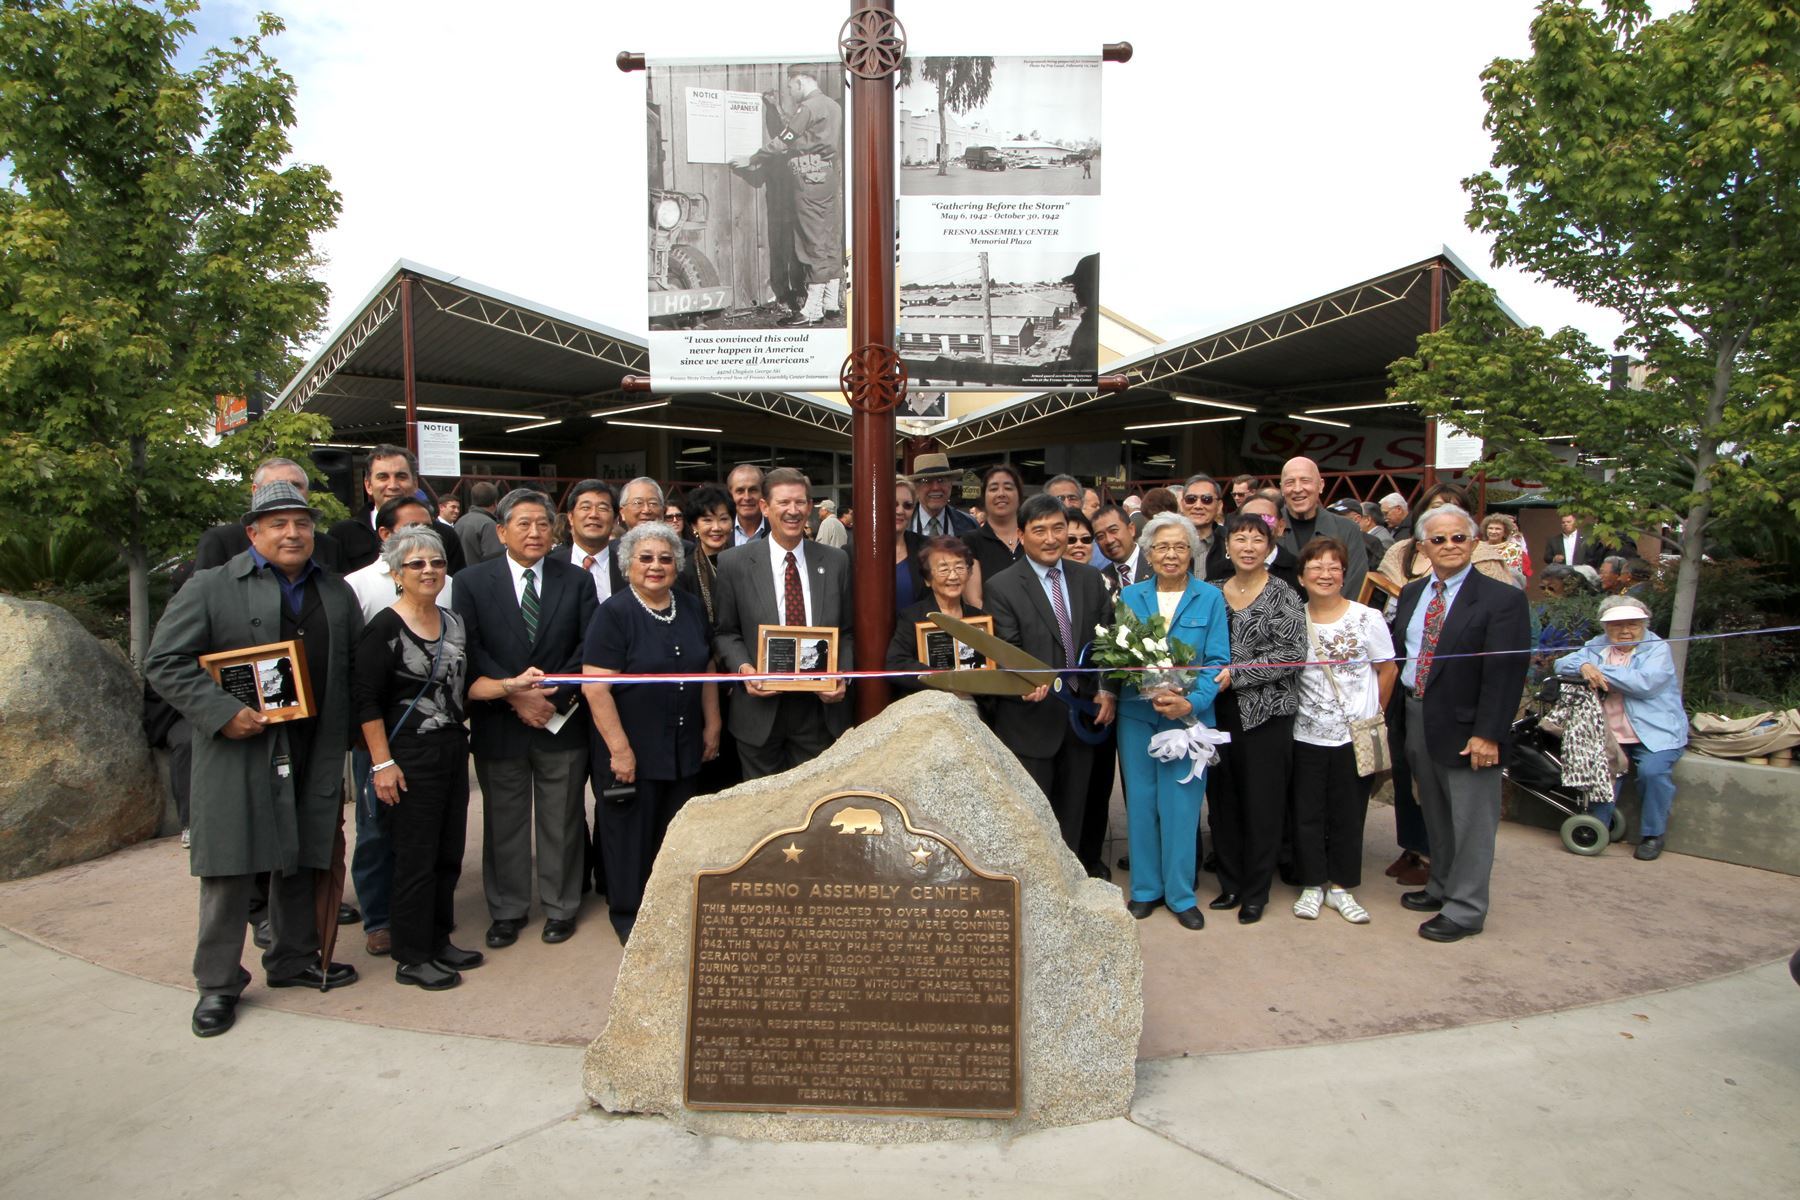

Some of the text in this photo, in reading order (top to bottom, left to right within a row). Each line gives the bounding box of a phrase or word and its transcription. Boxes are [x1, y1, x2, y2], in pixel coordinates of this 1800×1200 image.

[932, 202, 983, 211] “Gathering
[986, 202, 1016, 211] Before
[718, 346, 751, 355] happen
[746, 357, 758, 365] all
[1251, 421, 1365, 467] SPA
[730, 883, 980, 899] FRESNO ASSEMBLY CENTER
[703, 904, 724, 913] THIS
[731, 904, 790, 914] MEMORIAL
[794, 906, 803, 914] IS
[809, 906, 870, 916] DEDICATED
[876, 907, 891, 916] TO
[897, 907, 927, 917] OVER
[975, 909, 1009, 918] AMER-
[701, 916, 1009, 930] ICANS OF JAPANESE ANCESTRY WHO WERE CONFINED
[701, 928, 1009, 942] AT THE FRESNO FAIRGROUNDS FROM MAY TO OCTOBER
[699, 940, 1009, 954] 1942. THIS WAS AN EARLY PHASE OF THE MASS INCAR-
[699, 952, 757, 961] CERATION
[766, 953, 780, 962] OF
[786, 953, 817, 962] OVER
[877, 955, 935, 964] JAPANESE
[944, 956, 1009, 966] AMERICANS
[698, 964, 738, 973] DURING
[743, 964, 780, 974] WORLD
[786, 965, 810, 974] WAR
[825, 966, 882, 975] PURSUANT
[884, 967, 898, 976] TO
[905, 967, 968, 977] EXECUTIVE
[972, 969, 1009, 978] ORDER
[698, 976, 1009, 990] 9066. THEY WERE DETAINED WITHOUT CHARGES, TRIAL
[698, 988, 713, 997] OR
[718, 988, 804, 999] ESTABLISHMENT
[810, 990, 824, 999] OF
[866, 991, 889, 1000] MAY
[892, 991, 918, 1001] SUCH
[925, 992, 981, 1002] INJUSTICE
[986, 993, 1009, 1003] AND
[697, 1000, 757, 1010] SUFFERING
[764, 1001, 801, 1011] NEVER
[696, 1018, 761, 1029] CALIFORNIA
[768, 1020, 834, 1030] REGISTERED
[841, 1021, 902, 1032] HISTORICAL
[906, 1022, 967, 1033] LANDMARK
[695, 1037, 1009, 1052] PLAQUE PLACED BY THE STATE DEPARTMENT OF PARKS
[695, 1049, 1009, 1065] AND RECREATION IN COOPERATION WITH THE FRESNO
[694, 1062, 745, 1072] DISTRICT
[779, 1063, 837, 1074] JAPANESE
[844, 1064, 903, 1075] AMERICAN
[911, 1065, 960, 1076] CITIZENS
[965, 1066, 1009, 1077] LEAGUE
[693, 1074, 716, 1084] AND
[723, 1075, 745, 1085] THE
[752, 1075, 805, 1086] CENTRAL
[811, 1076, 881, 1087] CALIFORNIA
[932, 1078, 1009, 1090] FOUNDATION.
[798, 1089, 858, 1100] FEBRUARY
